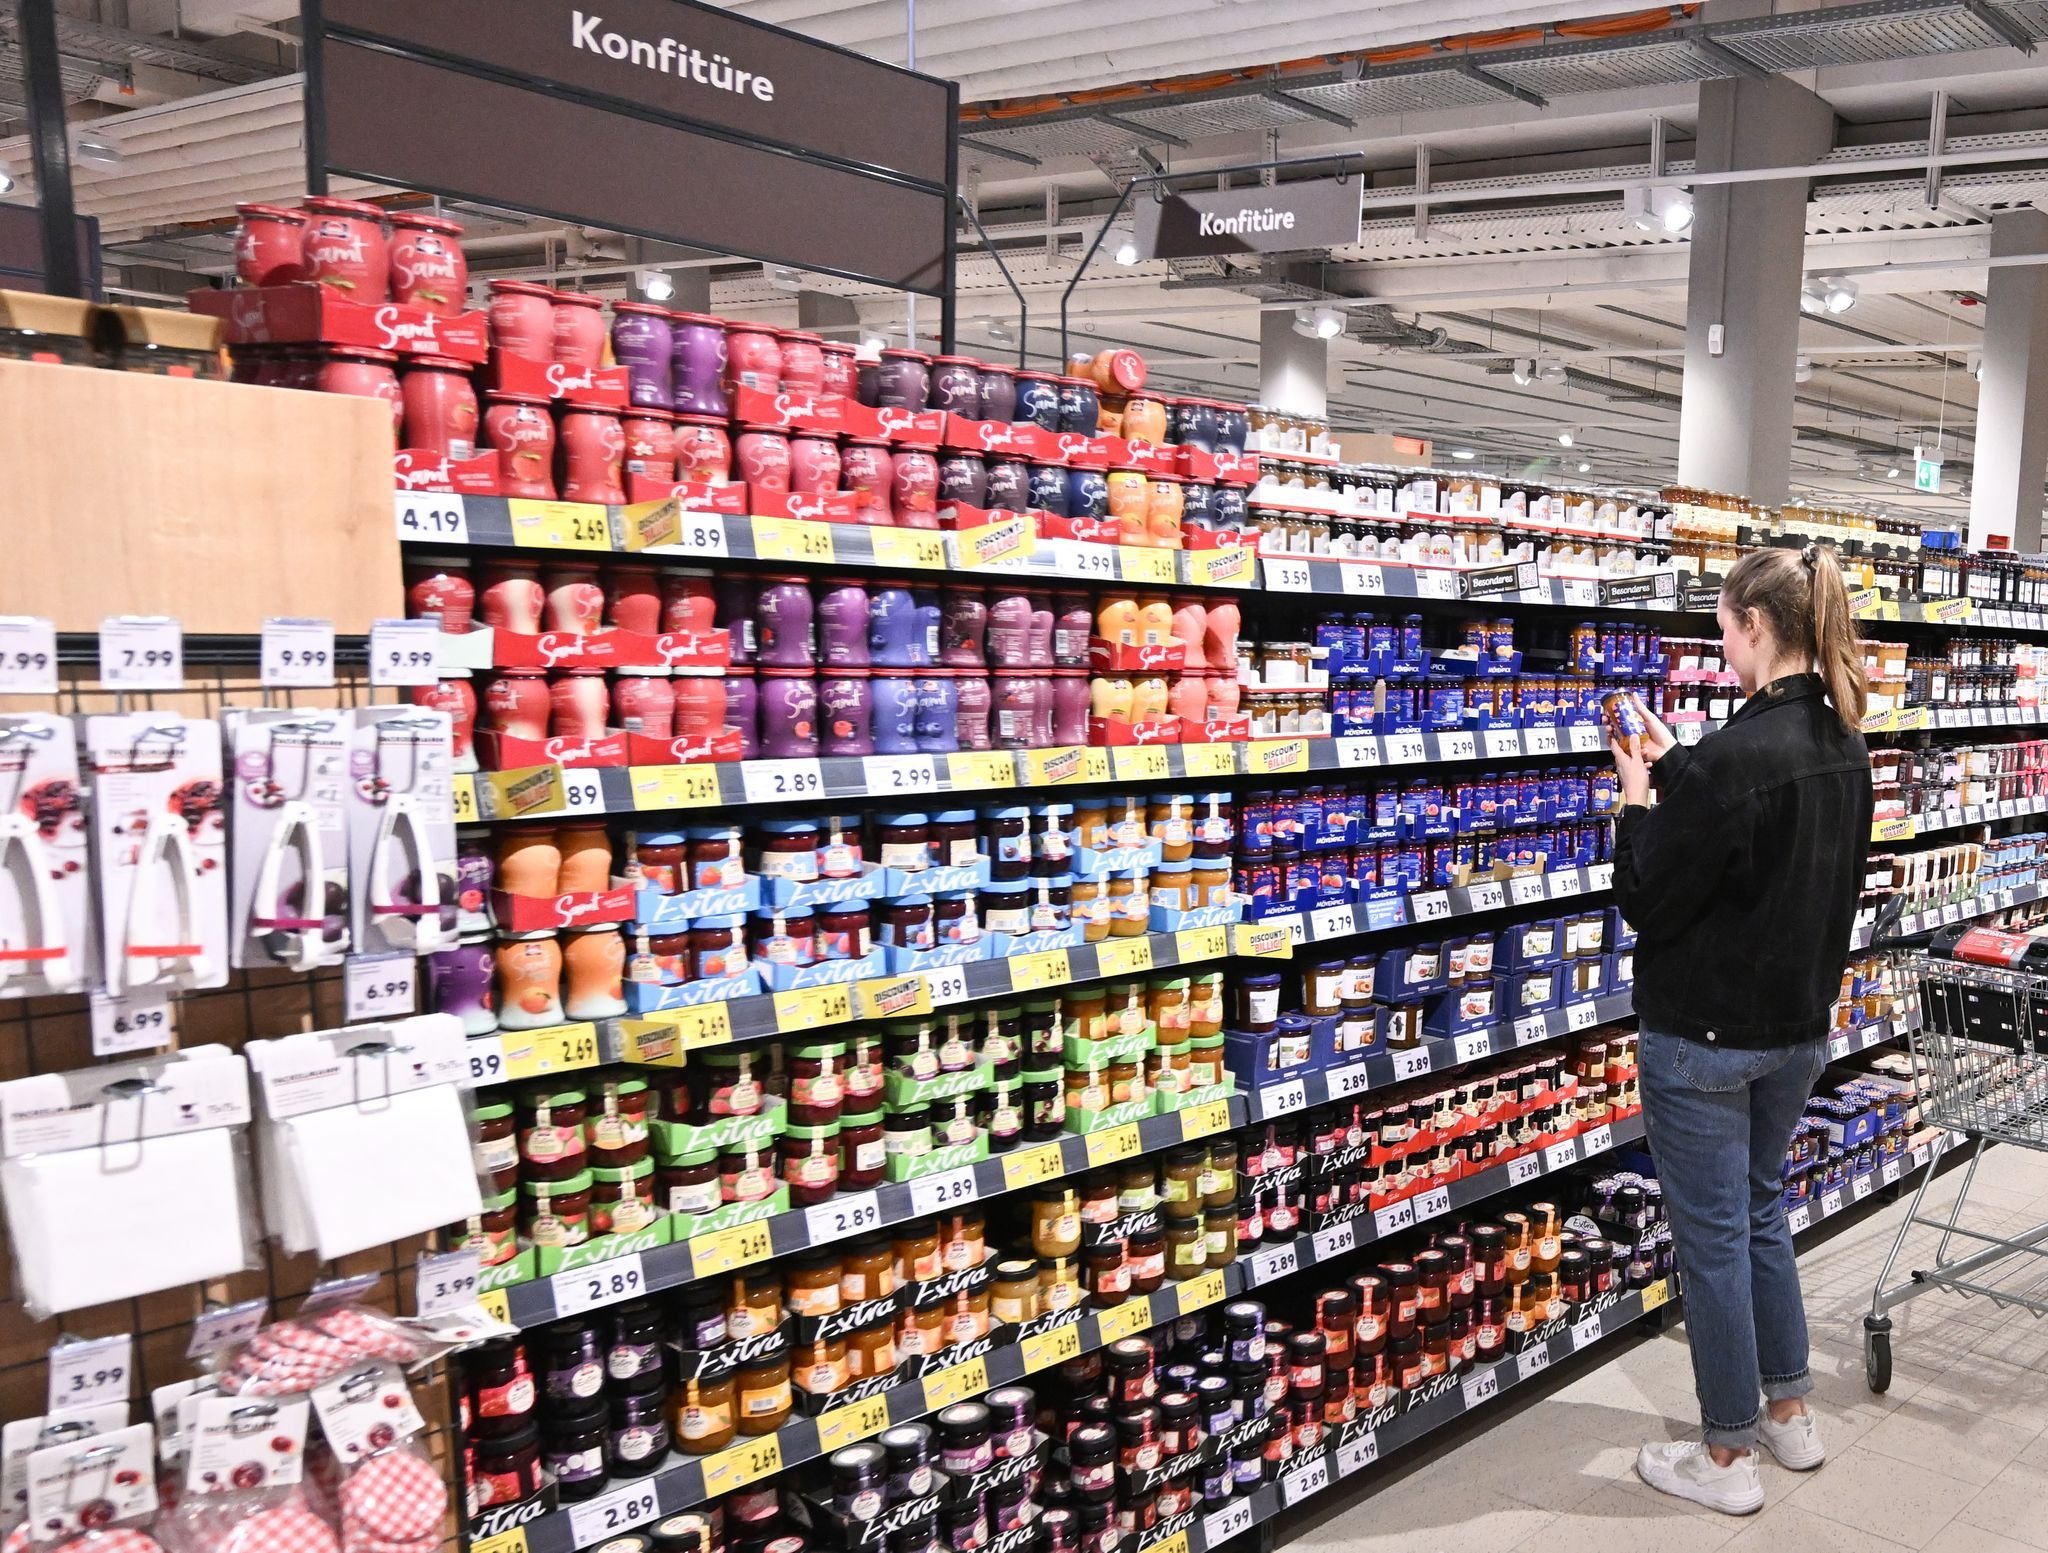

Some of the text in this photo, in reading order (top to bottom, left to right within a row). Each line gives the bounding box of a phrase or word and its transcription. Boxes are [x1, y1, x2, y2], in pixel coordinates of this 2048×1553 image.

[572, 10, 774, 102] Konfitüre
[1200, 208, 1295, 237] Konfitüre
[374, 306, 441, 350] Samt
[774, 394, 816, 425] Samt
[877, 407, 917, 438] Samt
[980, 424, 1014, 451] Samt
[1058, 435, 1091, 461] Samt
[1128, 439, 1158, 464] Samt
[1214, 453, 1243, 478] Samt
[402, 508, 460, 534] 4.19
[572, 518, 605, 542] 2.69
[802, 534, 829, 554] 2.69
[917, 543, 940, 562] 2.69
[1078, 554, 1110, 572] 2.99
[1154, 560, 1172, 578] 2.69
[1282, 570, 1307, 585] 3.59
[1358, 575, 1381, 588] 3.59
[1472, 569, 1514, 587] Besonderes
[1611, 584, 1650, 595] Besonderes
[122, 650, 173, 667] 7.99
[281, 650, 327, 666] 9.99
[389, 651, 433, 667] 9.99
[538, 635, 588, 667] Samt
[656, 636, 700, 666] Samt
[1140, 646, 1168, 669] Samt
[1340, 664, 1369, 673] MÖVENPICK
[1393, 663, 1420, 672] MÖVENPICK
[1134, 723, 1162, 744] Samt
[1206, 722, 1232, 742] Samt
[1344, 726, 1373, 735] MÖVENPICK
[1403, 745, 1422, 757] 3.19
[1453, 742, 1474, 755] 2.99
[1499, 739, 1517, 752] 2.79
[1538, 737, 1555, 749] 2.79
[1582, 735, 1599, 747] 2.79
[1214, 754, 1231, 770] 2.69
[1354, 747, 1376, 761] 2.79
[990, 764, 1010, 781] 2.69
[1088, 759, 1106, 777] 2.69
[1148, 756, 1166, 773] 2.69
[774, 774, 818, 792] 2.89
[892, 769, 930, 787] 2.99
[1470, 819, 1495, 828] MÖVENPICK
[1515, 815, 1537, 824] MÖVENPICK
[1556, 810, 1577, 818] MÖVENPICK
[1316, 834, 1345, 845] MÖVENPICK
[1368, 829, 1396, 839] MÖVENPICK
[1425, 826, 1450, 835] MÖVENPICK
[1091, 848, 1153, 873] Extra
[900, 867, 980, 896] Extra
[1524, 885, 1541, 898] 2.99
[1563, 878, 1578, 891] 3.19
[789, 880, 876, 906] Extra
[1316, 897, 1345, 908] MÖVENPICK
[1370, 889, 1397, 900] MÖVENPICK
[1482, 891, 1502, 905] 2.99
[555, 893, 604, 928] Samt
[654, 890, 749, 922] Extra
[1265, 904, 1295, 915] MÖVENPICK
[1428, 901, 1448, 915] 2.79
[1177, 907, 1236, 930] Extra
[1329, 915, 1351, 932] 2.79
[1005, 931, 1077, 956] Extra
[1208, 937, 1224, 952] 2.69
[909, 945, 983, 970] Extra
[1131, 950, 1149, 966] 2.69
[791, 962, 875, 988] Extra
[1047, 962, 1066, 980] 2.69
[366, 981, 409, 1000] 6.99
[656, 979, 752, 1010] Extra
[824, 997, 847, 1018] 2.69
[1579, 1011, 1595, 1024] 2.89
[114, 1011, 163, 1034] 6.99
[1527, 1025, 1545, 1039] 2.89
[562, 1038, 593, 1062] 2.69
[1087, 1033, 1150, 1063] Extra
[1468, 1041, 1488, 1056] 2.89
[1407, 1056, 1428, 1073] 2.89
[910, 1072, 986, 1105] Extra
[1343, 1074, 1365, 1091] 2.89
[1173, 1084, 1228, 1111] Extra
[1278, 1091, 1302, 1109] 2.89
[1089, 1102, 1151, 1133] Extra
[1211, 1109, 1227, 1127] 2.69
[685, 1116, 776, 1153] Extra
[1120, 1133, 1138, 1152] 2.69
[1594, 1133, 1611, 1149] 2.49
[905, 1145, 980, 1179] Extra
[1041, 1155, 1059, 1174] 2.69
[1320, 1146, 1366, 1174] Extra
[1558, 1149, 1574, 1163] 2.89
[1520, 1162, 1538, 1178] 2.89
[937, 1179, 972, 1202] 2.89
[1250, 1166, 1301, 1195] Extra
[1860, 1181, 1871, 1194] 2.29
[1427, 1196, 1448, 1213] 2.49
[1829, 1197, 1841, 1211] 2.29
[835, 1207, 875, 1231] 2.89
[1096, 1210, 1158, 1245] Extra
[1390, 1210, 1411, 1228] 2.49
[1572, 1217, 1595, 1230] Extra
[1329, 1232, 1352, 1251] 2.89
[560, 1233, 659, 1272] Extra
[1270, 1254, 1295, 1274] 2.89
[435, 1276, 475, 1298] 3.99
[588, 1271, 639, 1300] 2.89
[914, 1266, 989, 1307] Extra
[1207, 1280, 1222, 1299] 2.69
[1658, 1287, 1667, 1301] 2.69
[1578, 1291, 1618, 1322] Extra
[814, 1296, 896, 1341] Extra
[1016, 1306, 1083, 1343] Extra
[1131, 1307, 1148, 1327] 2.69
[1521, 1319, 1567, 1352] Extra
[1585, 1321, 1600, 1339] 4.19
[694, 1330, 784, 1379] Extra
[1058, 1335, 1076, 1355] 2.69
[918, 1338, 993, 1378] Extra
[1531, 1350, 1548, 1369] 4.19
[72, 1368, 124, 1391] 3.99
[962, 1369, 983, 1392] 2.69
[1476, 1380, 1496, 1398] 4.39
[821, 1374, 901, 1414] Extra
[1407, 1371, 1459, 1413] Extra
[862, 1407, 884, 1431] 2.69
[1339, 1401, 1397, 1447] Extra
[1216, 1416, 1271, 1455] Extra
[751, 1447, 777, 1474] 2.69
[1354, 1443, 1375, 1463] 4.19
[967, 1453, 1039, 1498] Extra
[1142, 1454, 1202, 1490] Extra
[1301, 1469, 1325, 1492] 2.89
[605, 1495, 653, 1529] 2.89
[861, 1495, 941, 1545] Extra
[1222, 1509, 1249, 1533] 2.99
[1139, 1509, 1196, 1548] Extra
